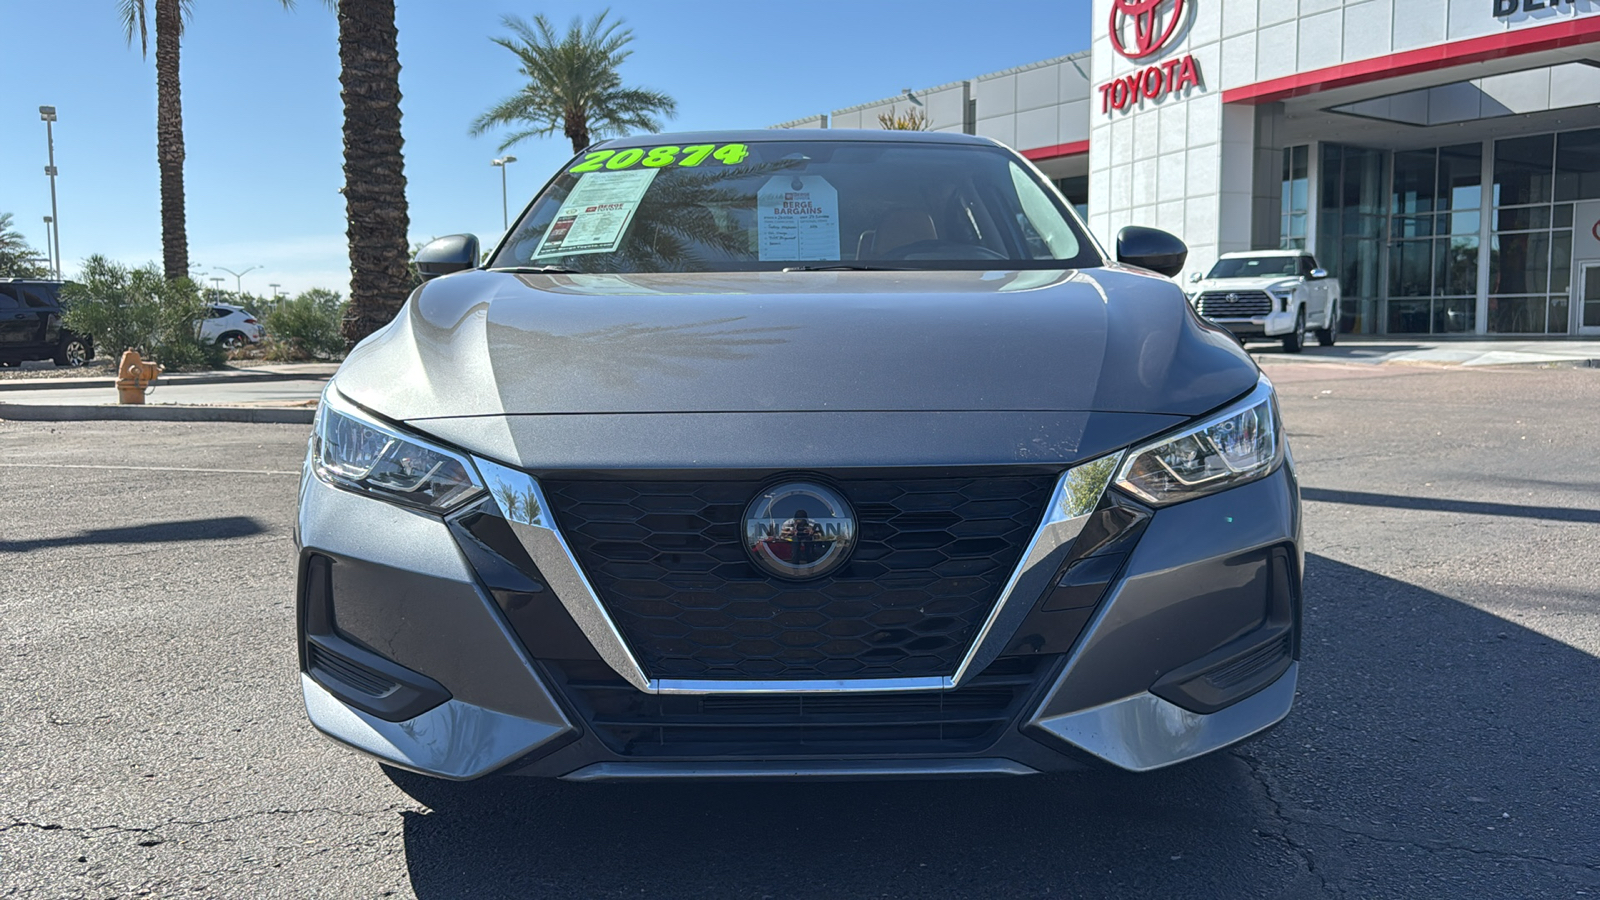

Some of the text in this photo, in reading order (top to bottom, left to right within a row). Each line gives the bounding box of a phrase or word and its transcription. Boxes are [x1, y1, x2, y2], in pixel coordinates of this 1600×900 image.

[1098, 54, 1198, 115] TOYOTA
[569, 143, 749, 173] 20874
[774, 207, 823, 215] BARGAINS
[783, 201, 813, 209] BERGE
[758, 522, 841, 537] NIAN
